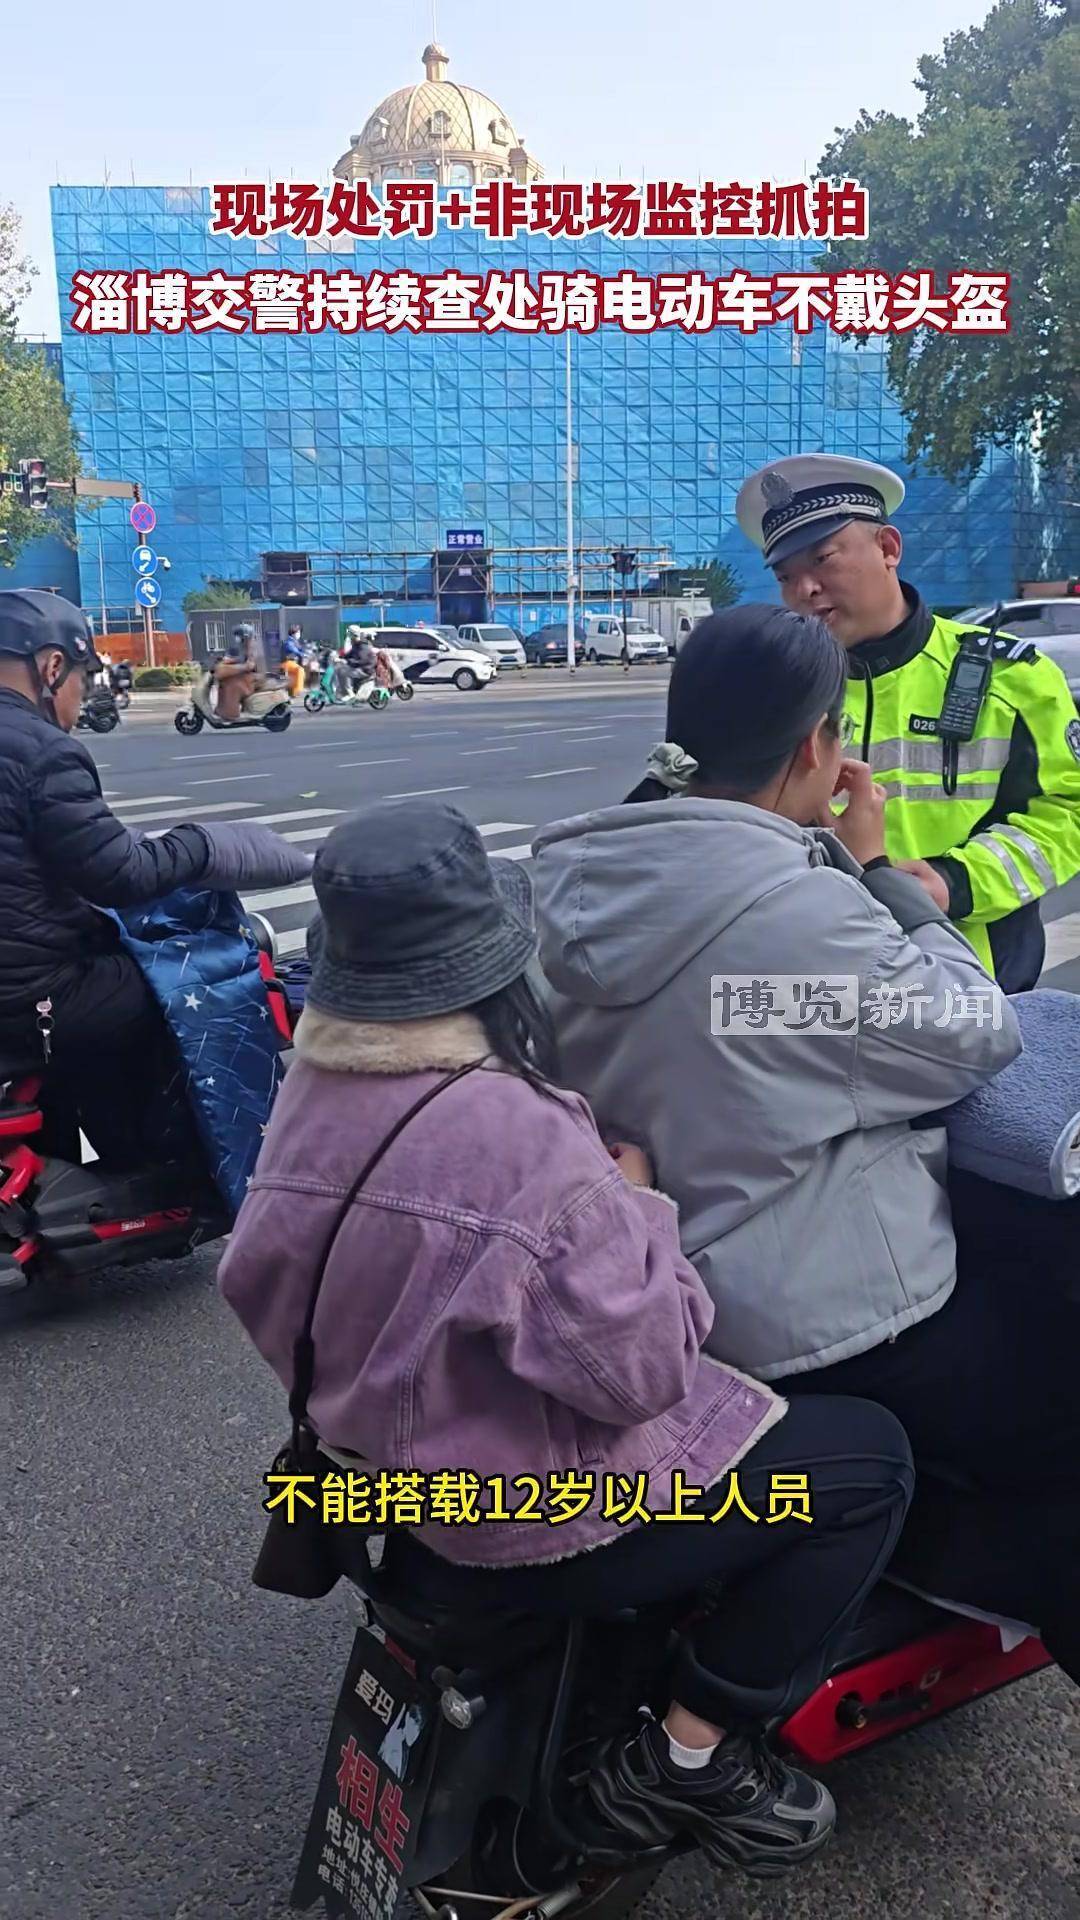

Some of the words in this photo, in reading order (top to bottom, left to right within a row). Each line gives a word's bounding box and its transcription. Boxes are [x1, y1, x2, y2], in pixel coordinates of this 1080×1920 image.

[447, 534, 483, 545] 正常营业
[354, 1668, 395, 1726] 爱玛
[335, 1735, 411, 1874] 相生
